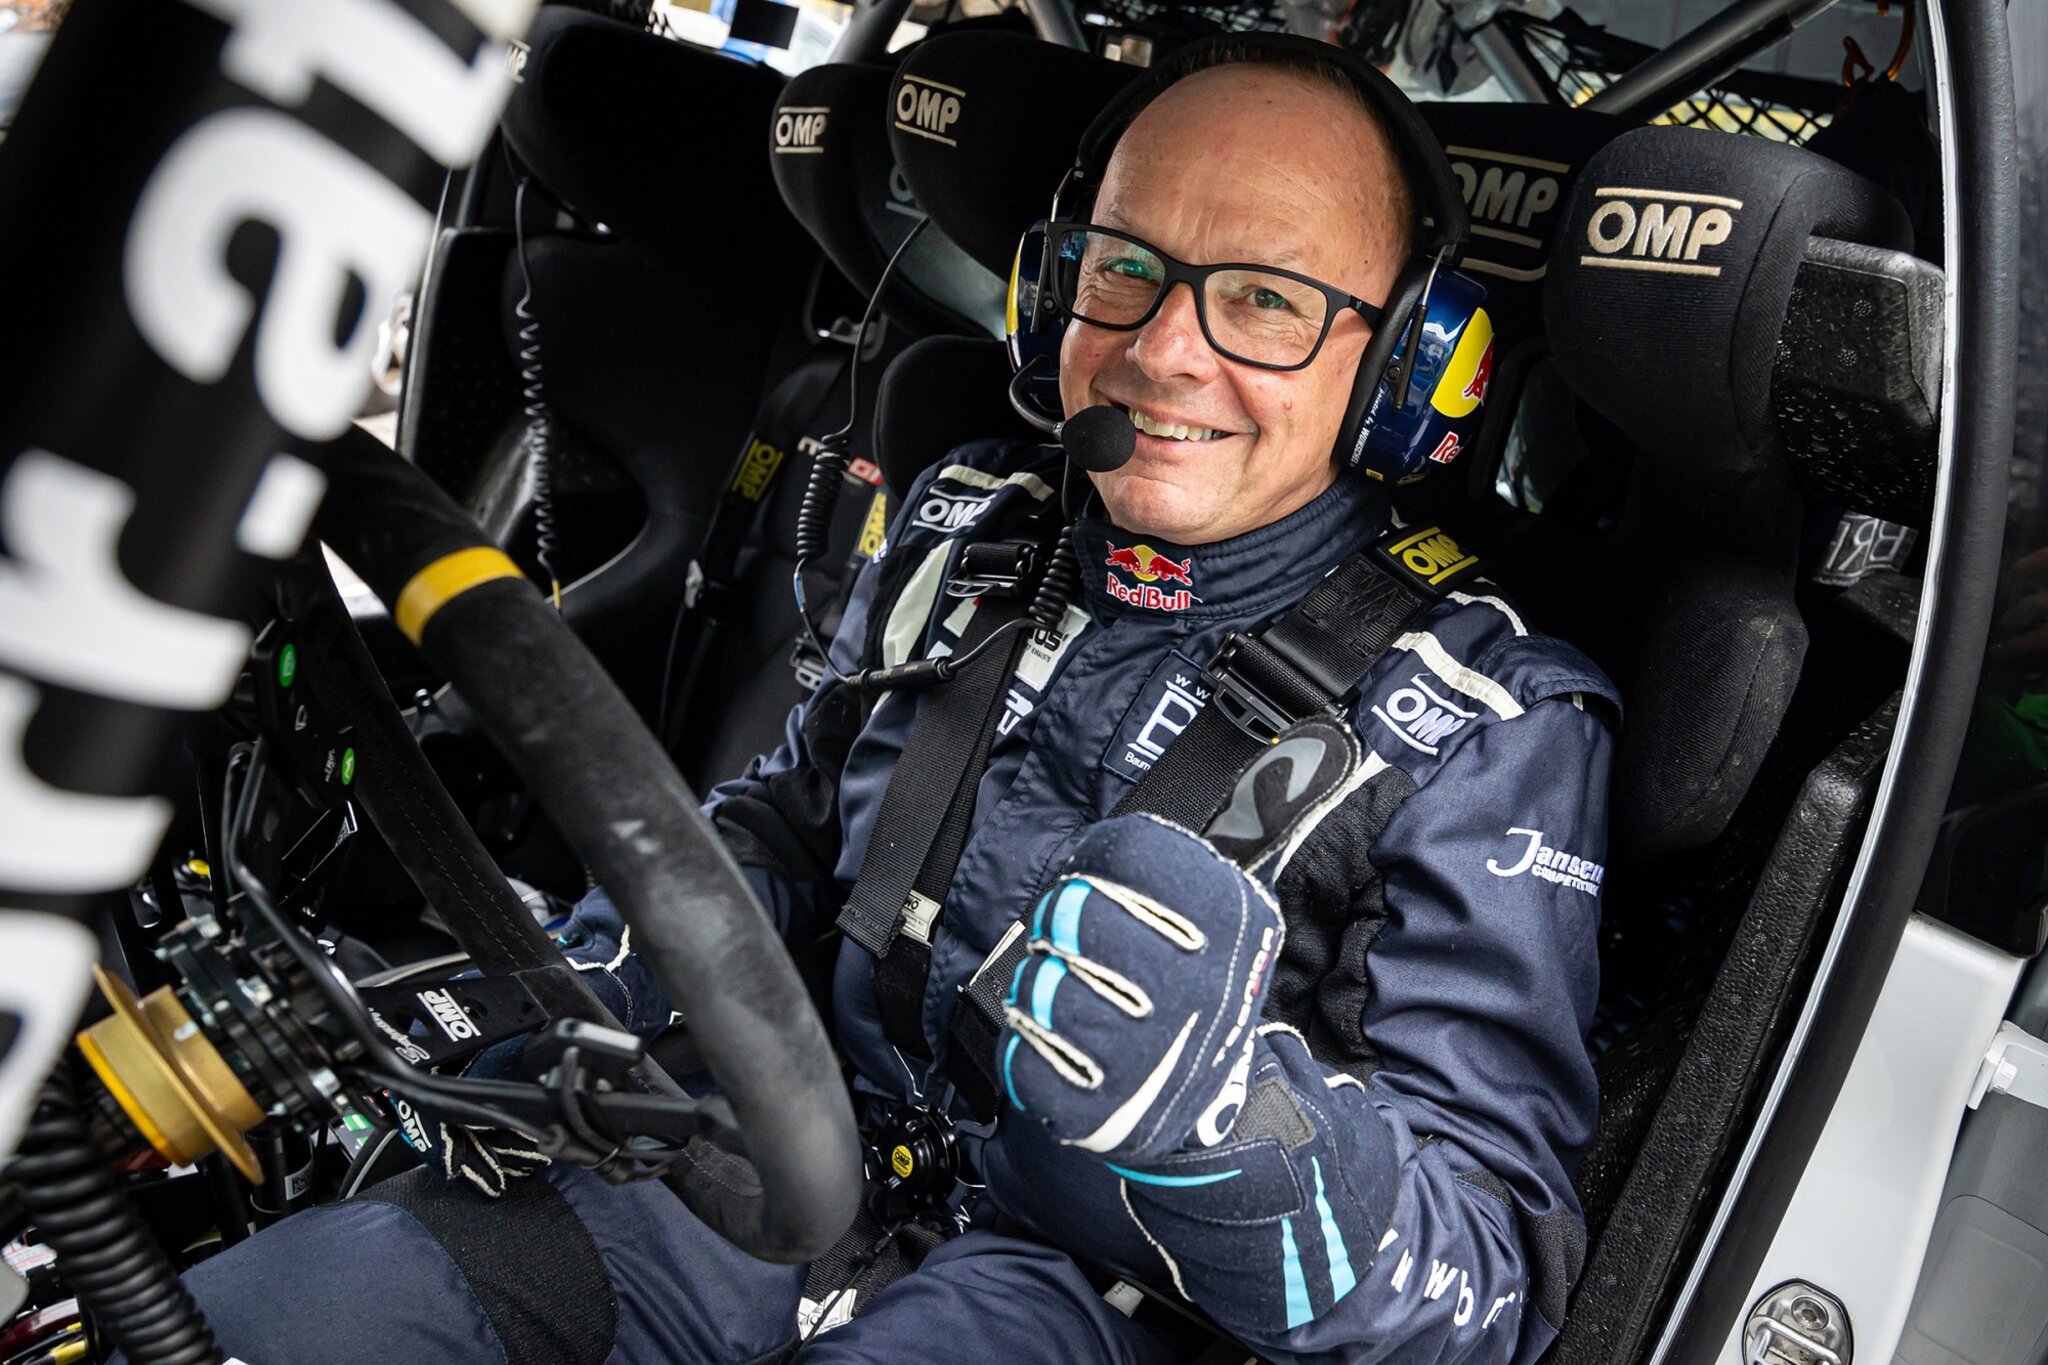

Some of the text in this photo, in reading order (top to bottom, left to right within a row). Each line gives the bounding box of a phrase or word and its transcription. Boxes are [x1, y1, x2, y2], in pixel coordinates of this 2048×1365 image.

[776, 114, 827, 146] OMP
[897, 84, 960, 133] OMP
[1587, 200, 1733, 260] OMP
[742, 443, 777, 499] OMP
[1429, 431, 1460, 464] Re
[920, 498, 991, 527] OMP
[1403, 534, 1465, 576] OMP
[1106, 571, 1192, 611] Red Bull
[1386, 688, 1467, 746] OMP
[1486, 827, 1604, 884] Jansen
[424, 990, 473, 1039] OMP
[397, 1099, 427, 1153] OMP
